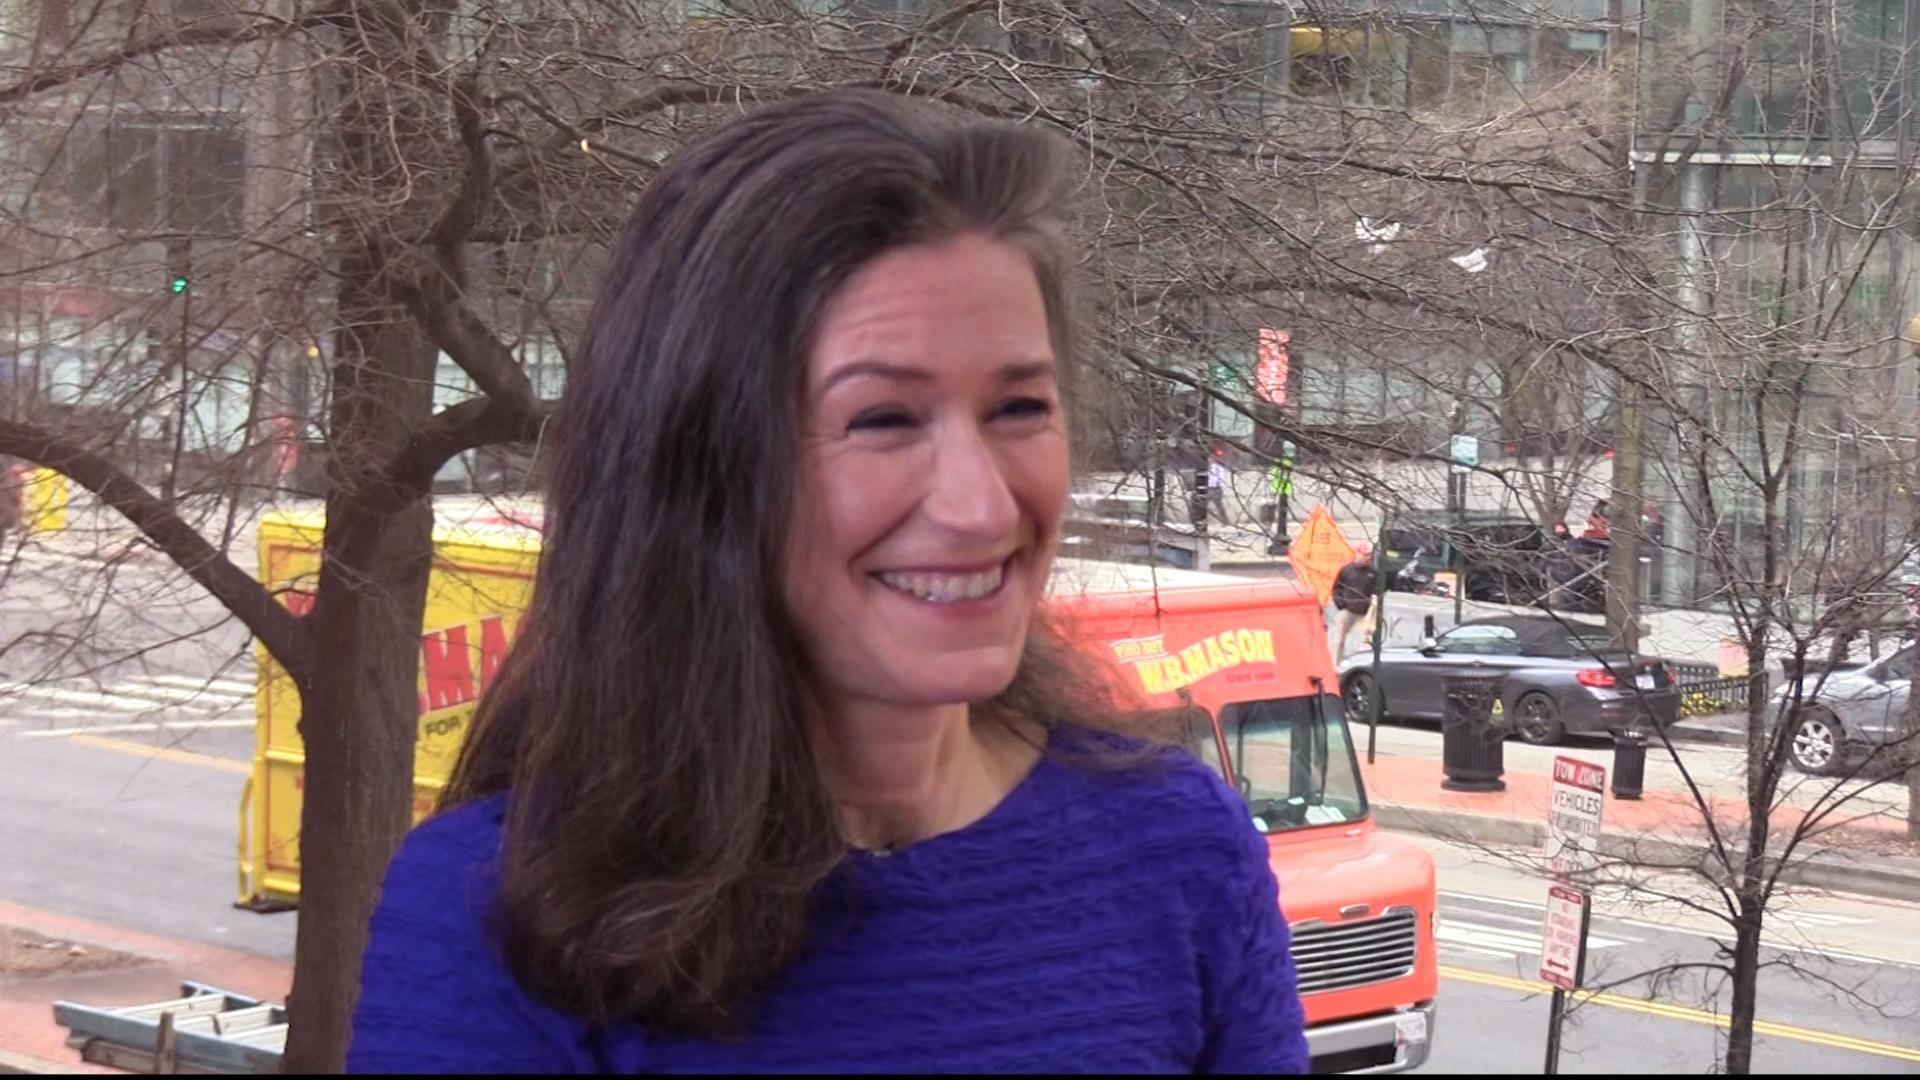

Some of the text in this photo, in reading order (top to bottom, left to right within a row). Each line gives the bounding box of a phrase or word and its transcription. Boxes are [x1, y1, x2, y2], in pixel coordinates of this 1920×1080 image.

[425, 714, 461, 737] FOR
[1555, 760, 1604, 789] TOW ZONE
[1553, 790, 1600, 816] VEHICLES
